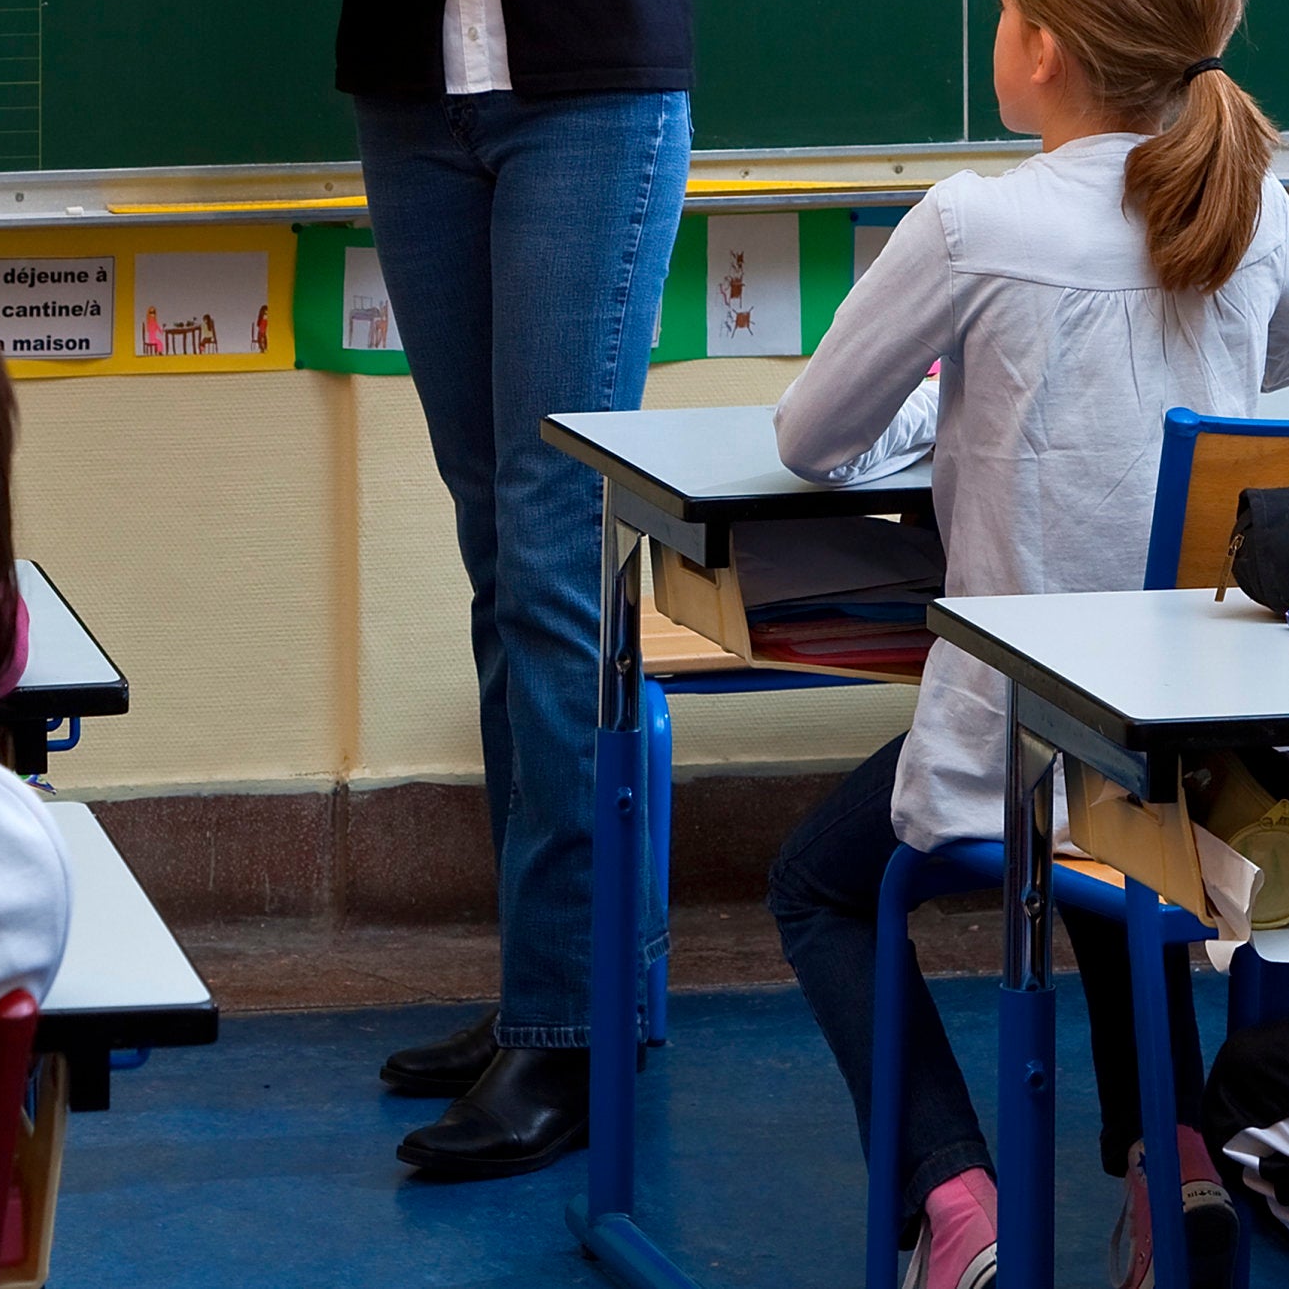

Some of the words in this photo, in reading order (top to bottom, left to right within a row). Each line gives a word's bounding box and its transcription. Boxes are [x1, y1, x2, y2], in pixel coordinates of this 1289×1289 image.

[3, 268, 89, 288] déjeune
[96, 266, 108, 283] à
[1, 300, 101, 318] cantine/à
[12, 336, 90, 351] maison
